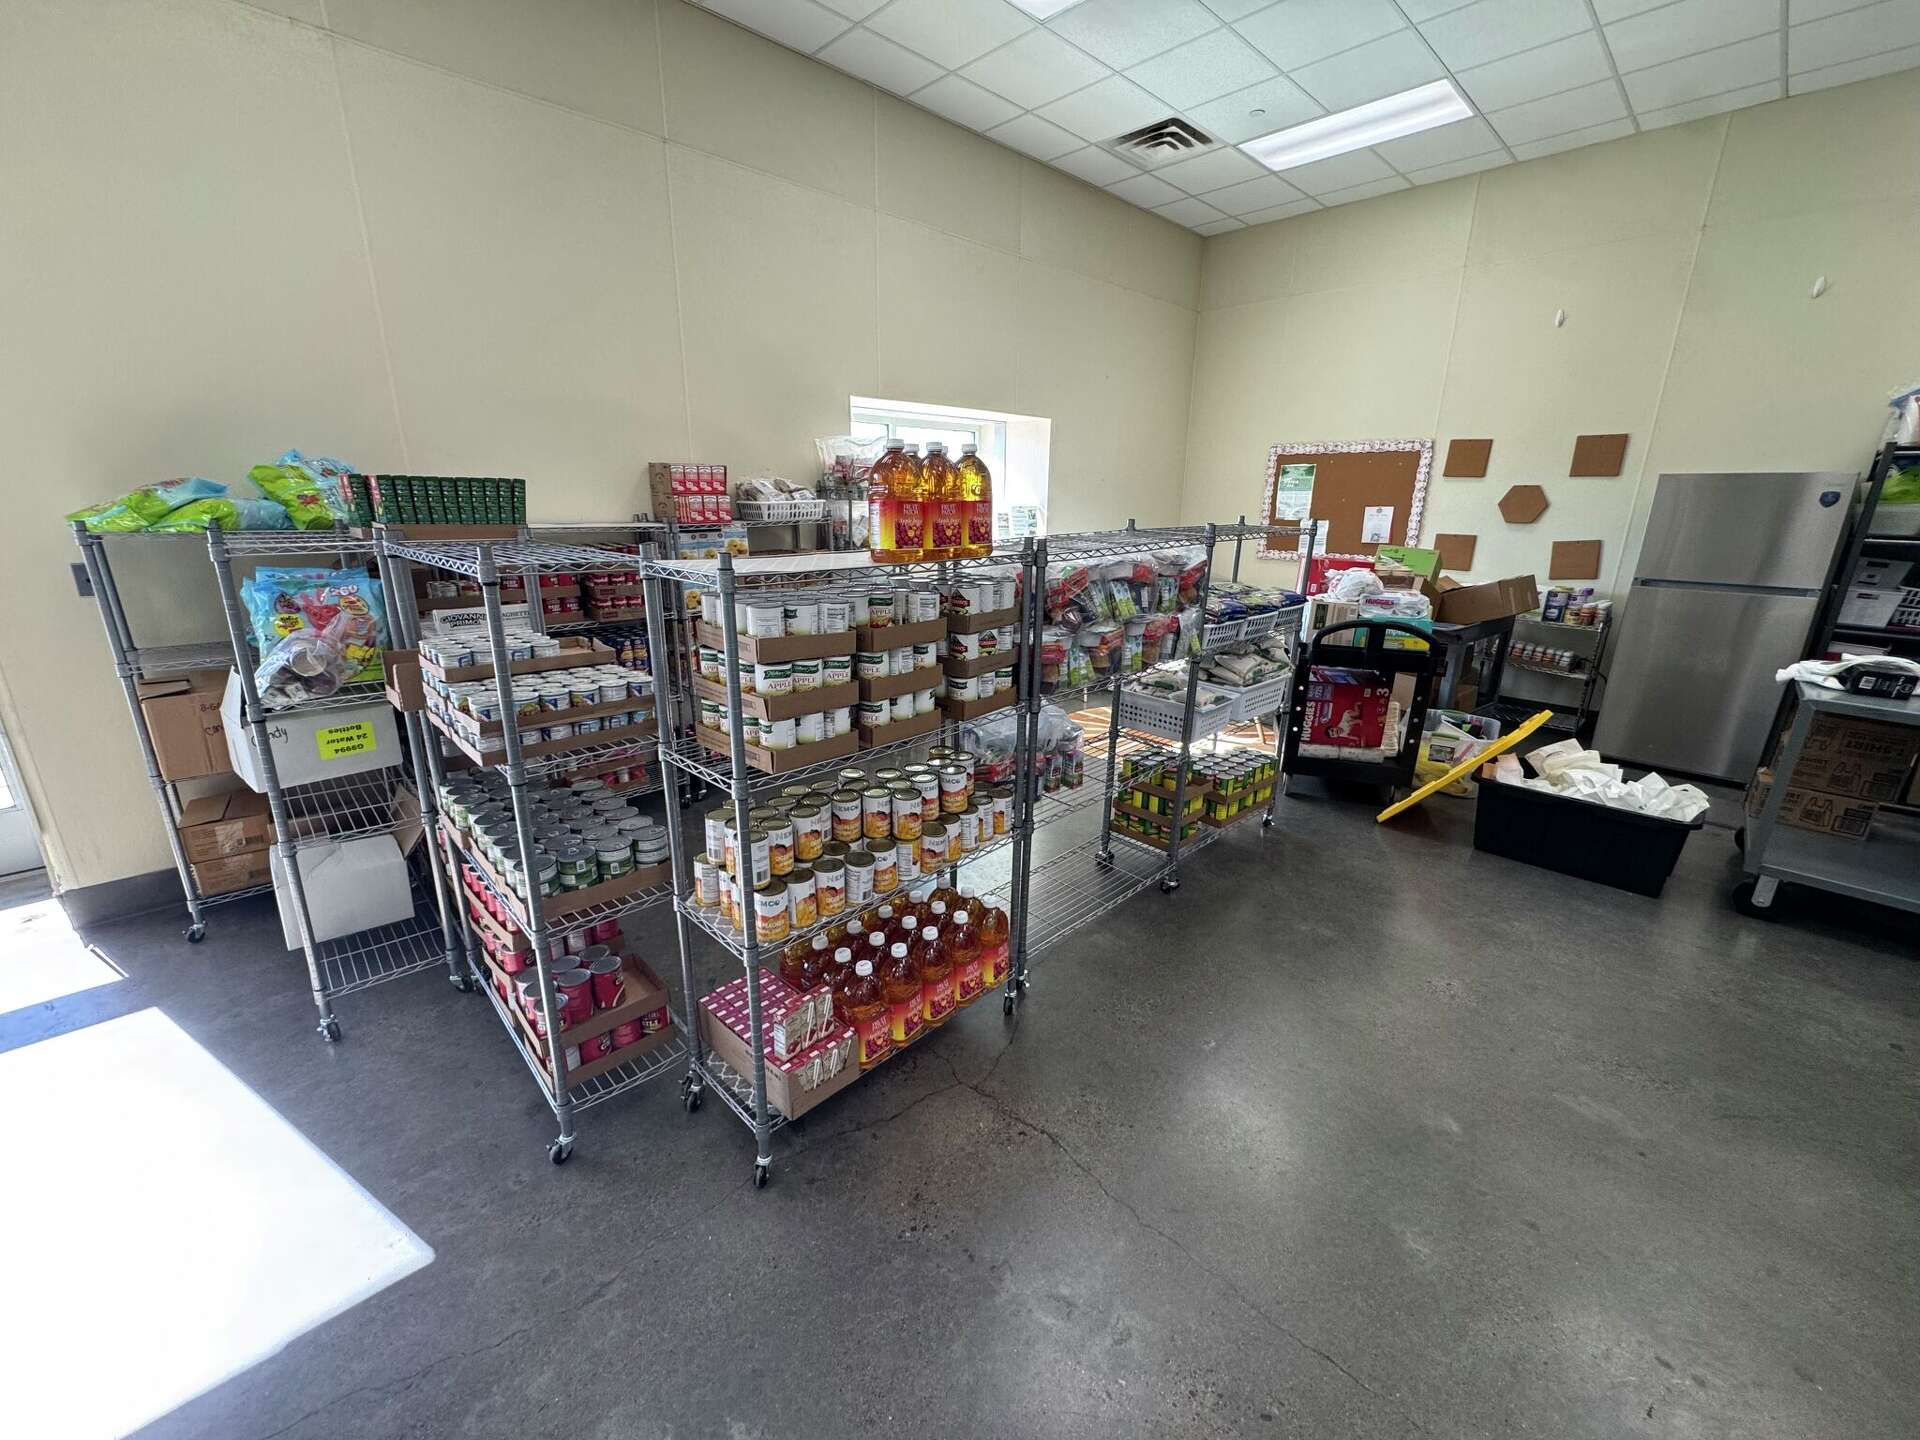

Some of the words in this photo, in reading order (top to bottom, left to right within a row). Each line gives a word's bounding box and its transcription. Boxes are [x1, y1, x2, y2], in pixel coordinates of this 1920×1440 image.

[449, 619, 481, 628] PRIMO
[793, 676, 815, 684] APPLE
[826, 672, 848, 681] APPLE
[767, 680, 792, 690] APPLE
[1376, 688, 1390, 697] 3
[1300, 701, 1316, 741] HUGGIES
[327, 724, 362, 735] Bottles
[326, 735, 355, 745] Water
[357, 732, 368, 741] 24
